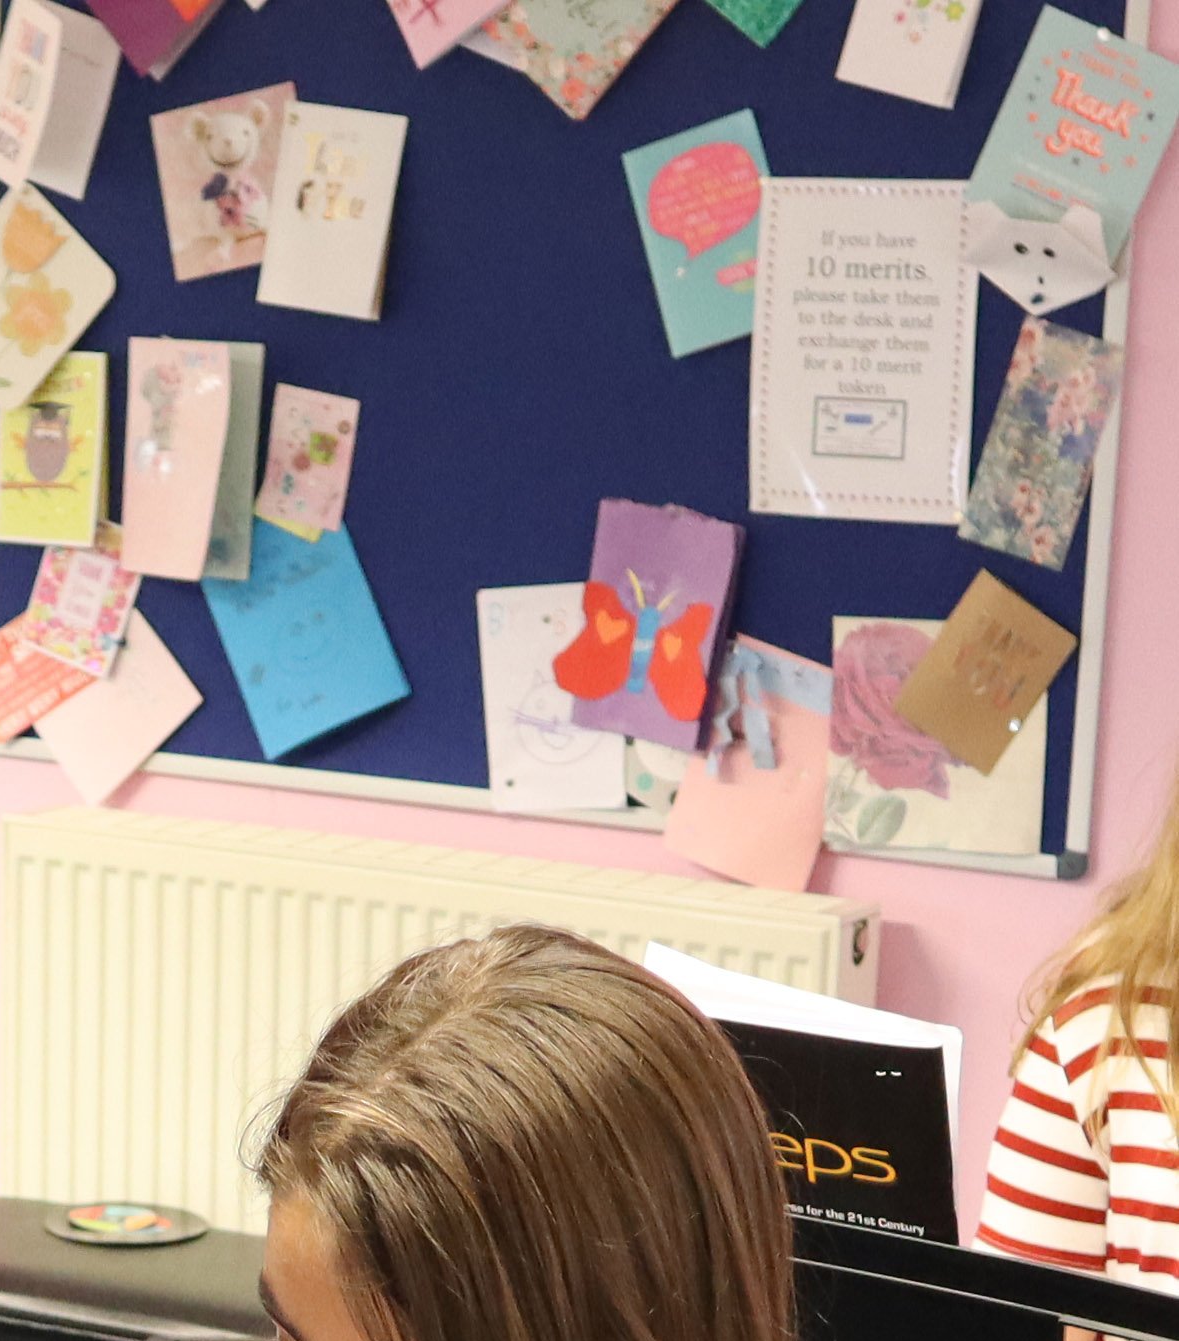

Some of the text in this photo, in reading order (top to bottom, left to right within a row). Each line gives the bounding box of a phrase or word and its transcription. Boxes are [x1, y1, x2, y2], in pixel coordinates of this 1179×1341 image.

[1051, 67, 1141, 140] Thank
[1044, 117, 1104, 158] you
[838, 234, 871, 251] you
[876, 231, 917, 248] have
[807, 255, 836, 278] 10
[793, 286, 941, 306] please take them
[798, 311, 934, 328] to the desk and
[798, 333, 930, 352] exchange them
[804, 352, 923, 374] for a 10 merit
[838, 379, 887, 395] token
[806, 1204, 824, 1217] for
[825, 1208, 845, 1221] the
[847, 1211, 876, 1228] 21st
[878, 1217, 925, 1237] Century
